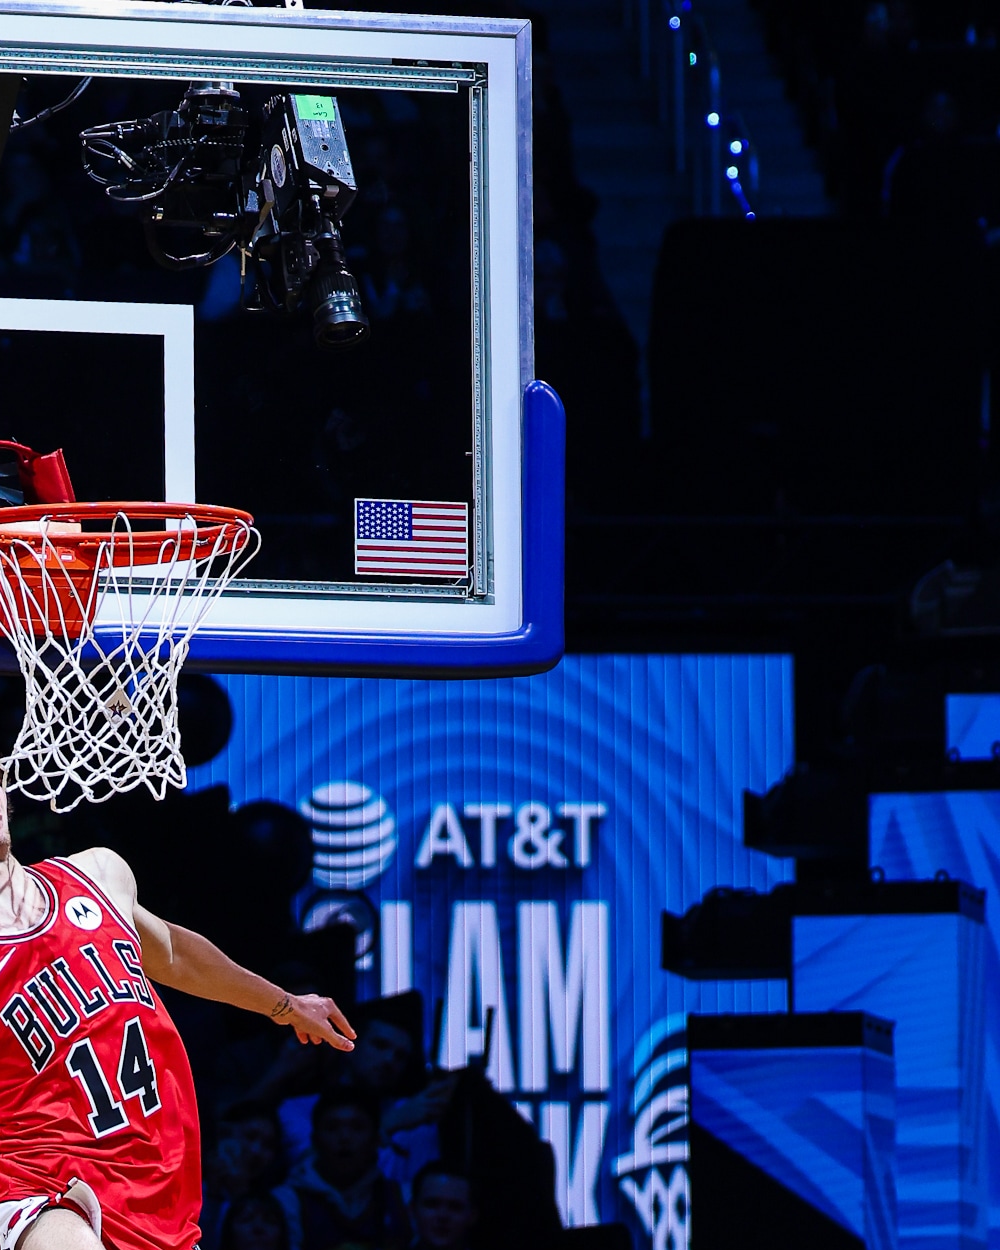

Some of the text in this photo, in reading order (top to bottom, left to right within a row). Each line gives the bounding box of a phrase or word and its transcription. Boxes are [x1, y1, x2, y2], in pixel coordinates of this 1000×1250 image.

[415, 801, 607, 870] AT&T
[0, 939, 156, 1076] BULLS
[354, 900, 611, 1093] AM
[65, 1015, 163, 1140] 14
